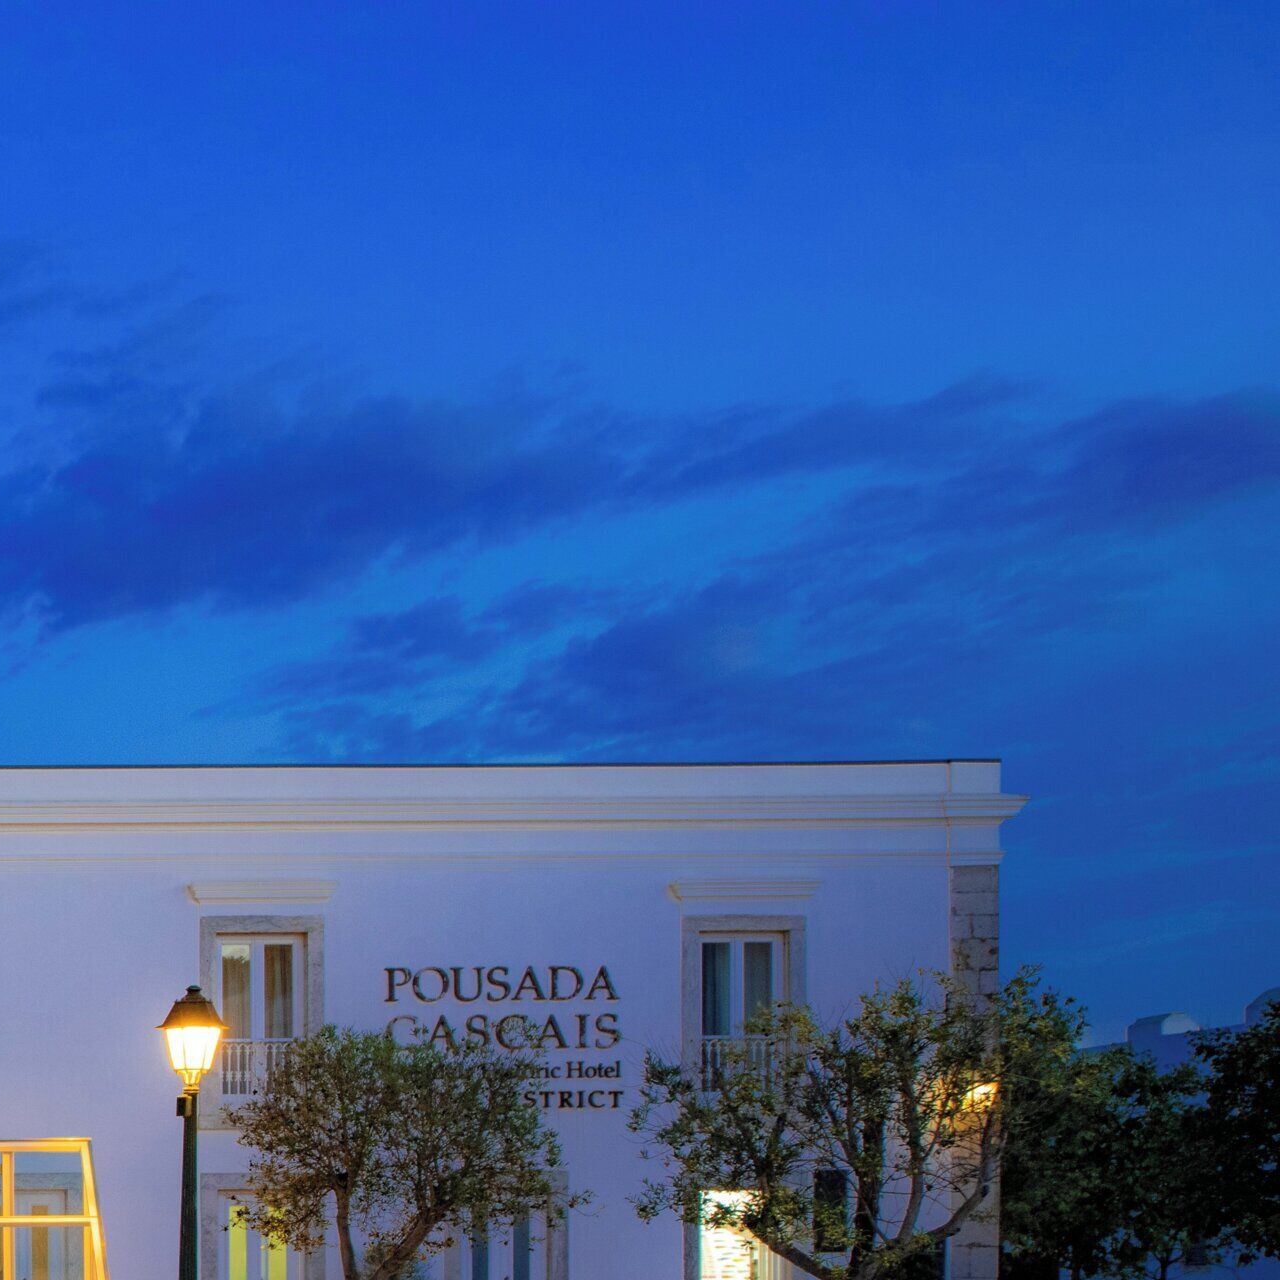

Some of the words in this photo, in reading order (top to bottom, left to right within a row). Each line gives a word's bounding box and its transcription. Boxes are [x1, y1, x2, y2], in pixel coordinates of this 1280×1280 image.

[383, 965, 620, 1003] POUSADA
[566, 1060, 622, 1079] Hotel
[523, 1089, 624, 1109] STRICT
